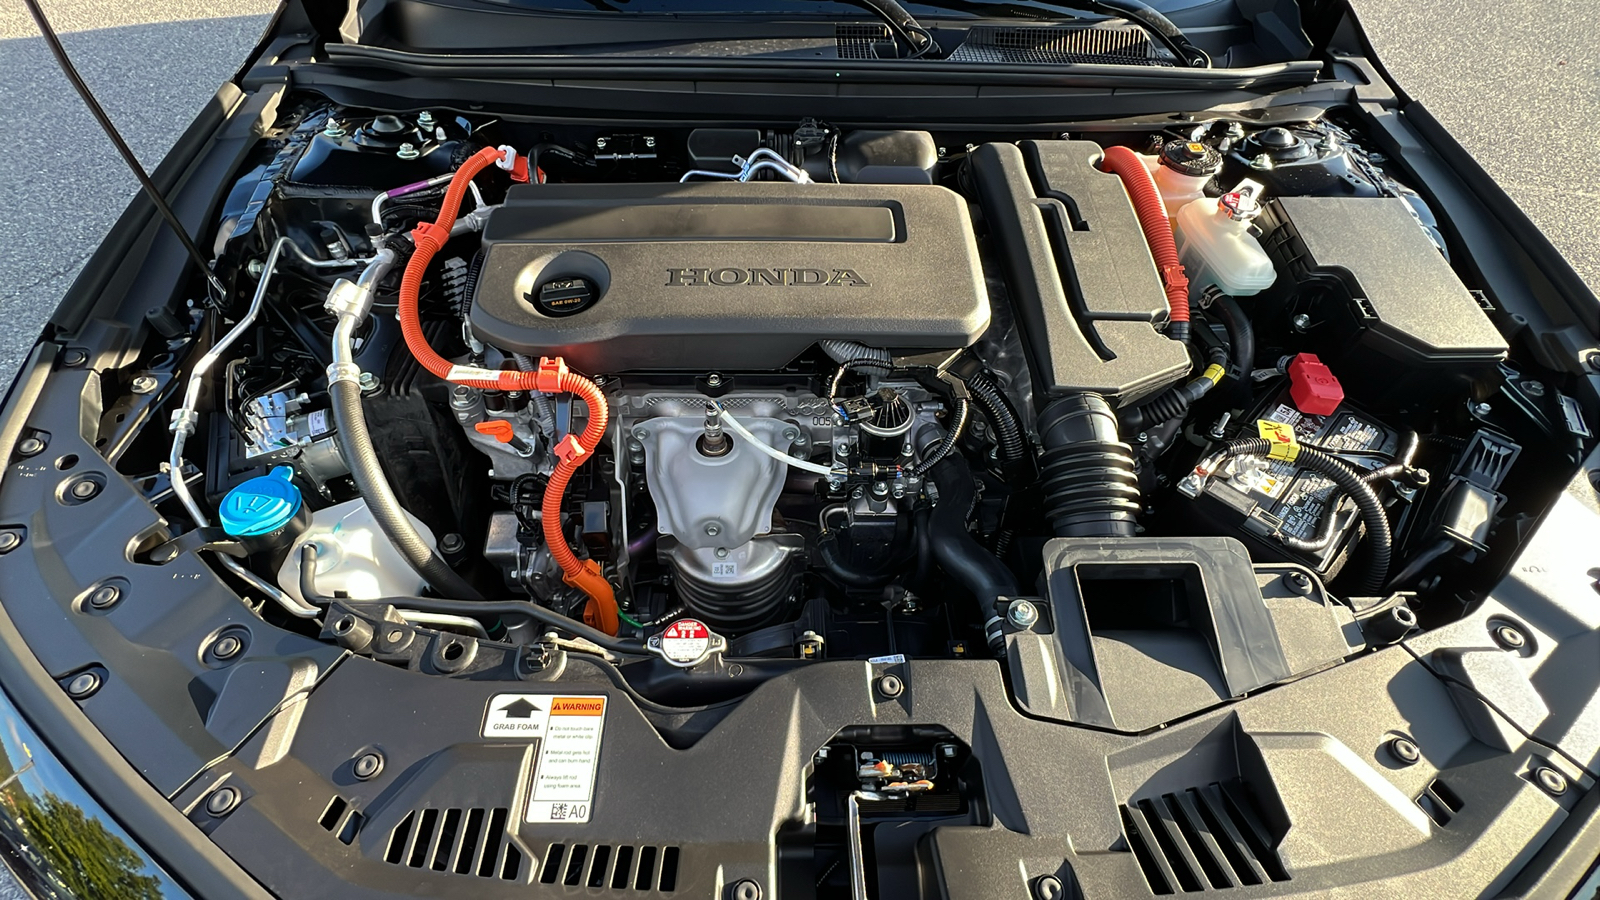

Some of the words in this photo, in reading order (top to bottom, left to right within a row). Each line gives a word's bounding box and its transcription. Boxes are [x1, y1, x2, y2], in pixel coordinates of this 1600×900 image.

[665, 268, 872, 286] HONDA
[813, 416, 831, 426] 005
[562, 703, 601, 711] WARNING
[568, 804, 587, 819] A0
